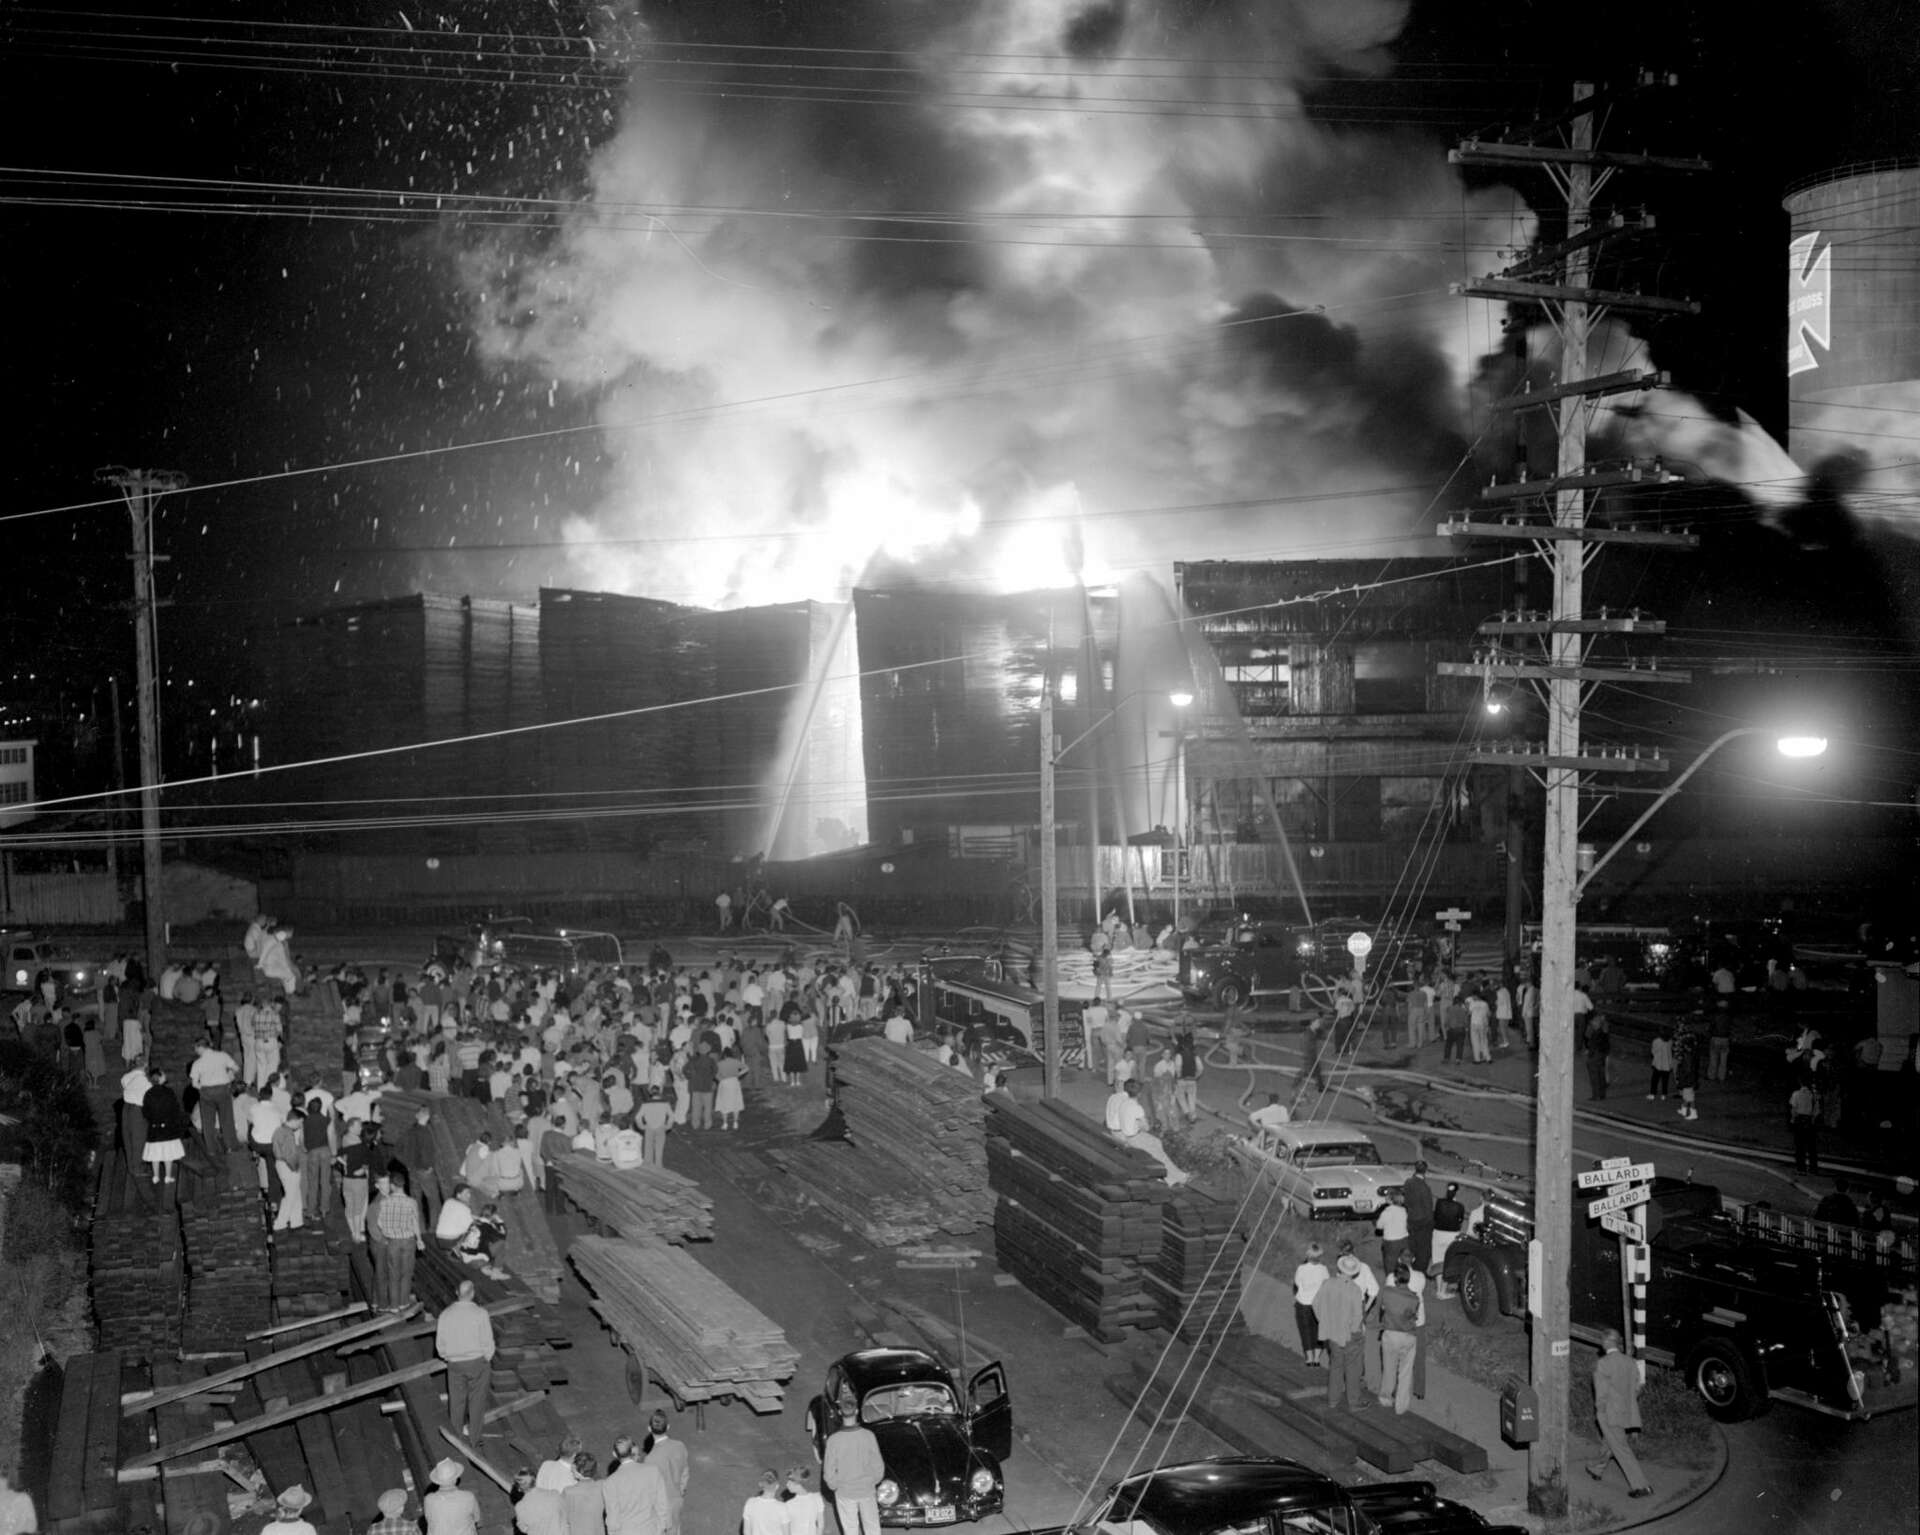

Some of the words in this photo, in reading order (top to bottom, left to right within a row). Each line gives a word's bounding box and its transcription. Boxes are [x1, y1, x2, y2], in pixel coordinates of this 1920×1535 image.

[1350, 939, 1370, 950] STOP
[1584, 1168, 1640, 1185] BALLARD
[1593, 1191, 1639, 1215] BALLARD
